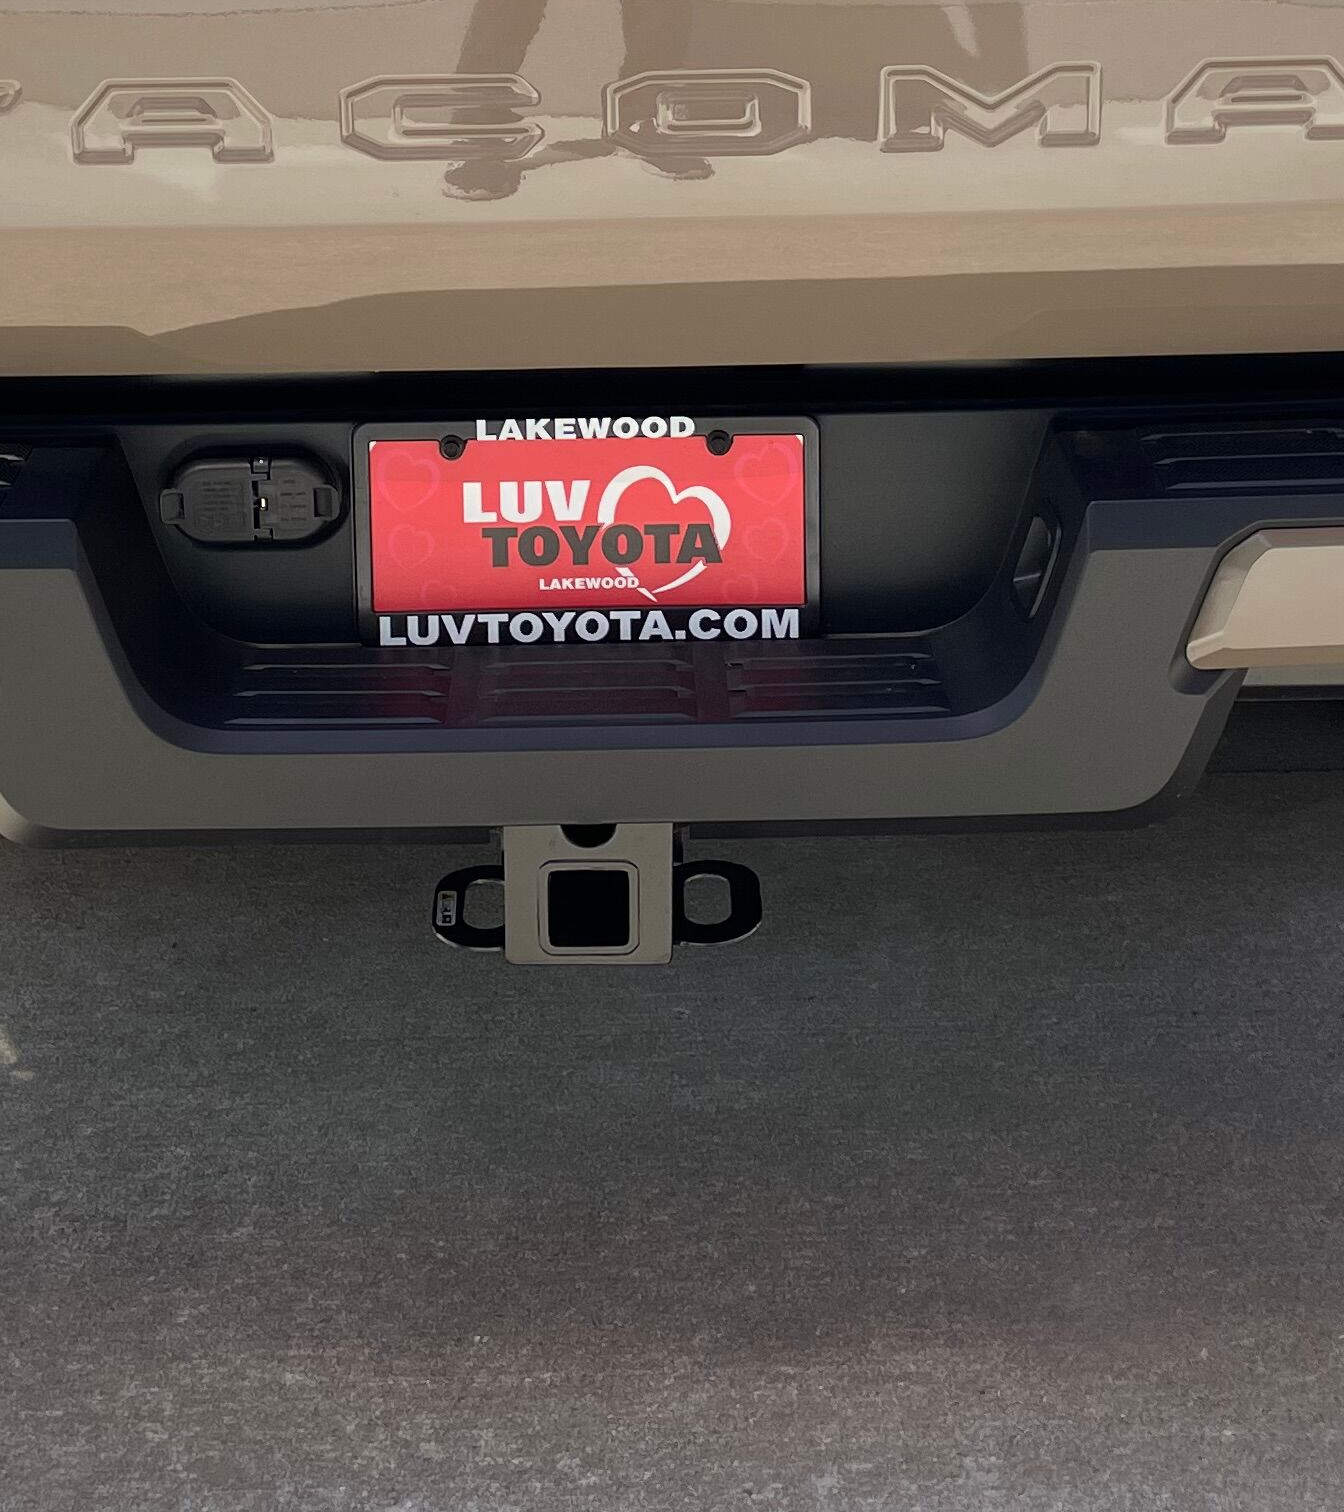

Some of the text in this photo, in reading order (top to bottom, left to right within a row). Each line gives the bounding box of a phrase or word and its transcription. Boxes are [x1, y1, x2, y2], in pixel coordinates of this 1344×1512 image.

[475, 416, 696, 442] LAKEWOOD
[462, 479, 591, 524] LUV
[482, 523, 723, 568] TOYOTA
[539, 575, 640, 591] LAKEWOOD
[379, 608, 800, 647] LUVTOYOTA.COM
